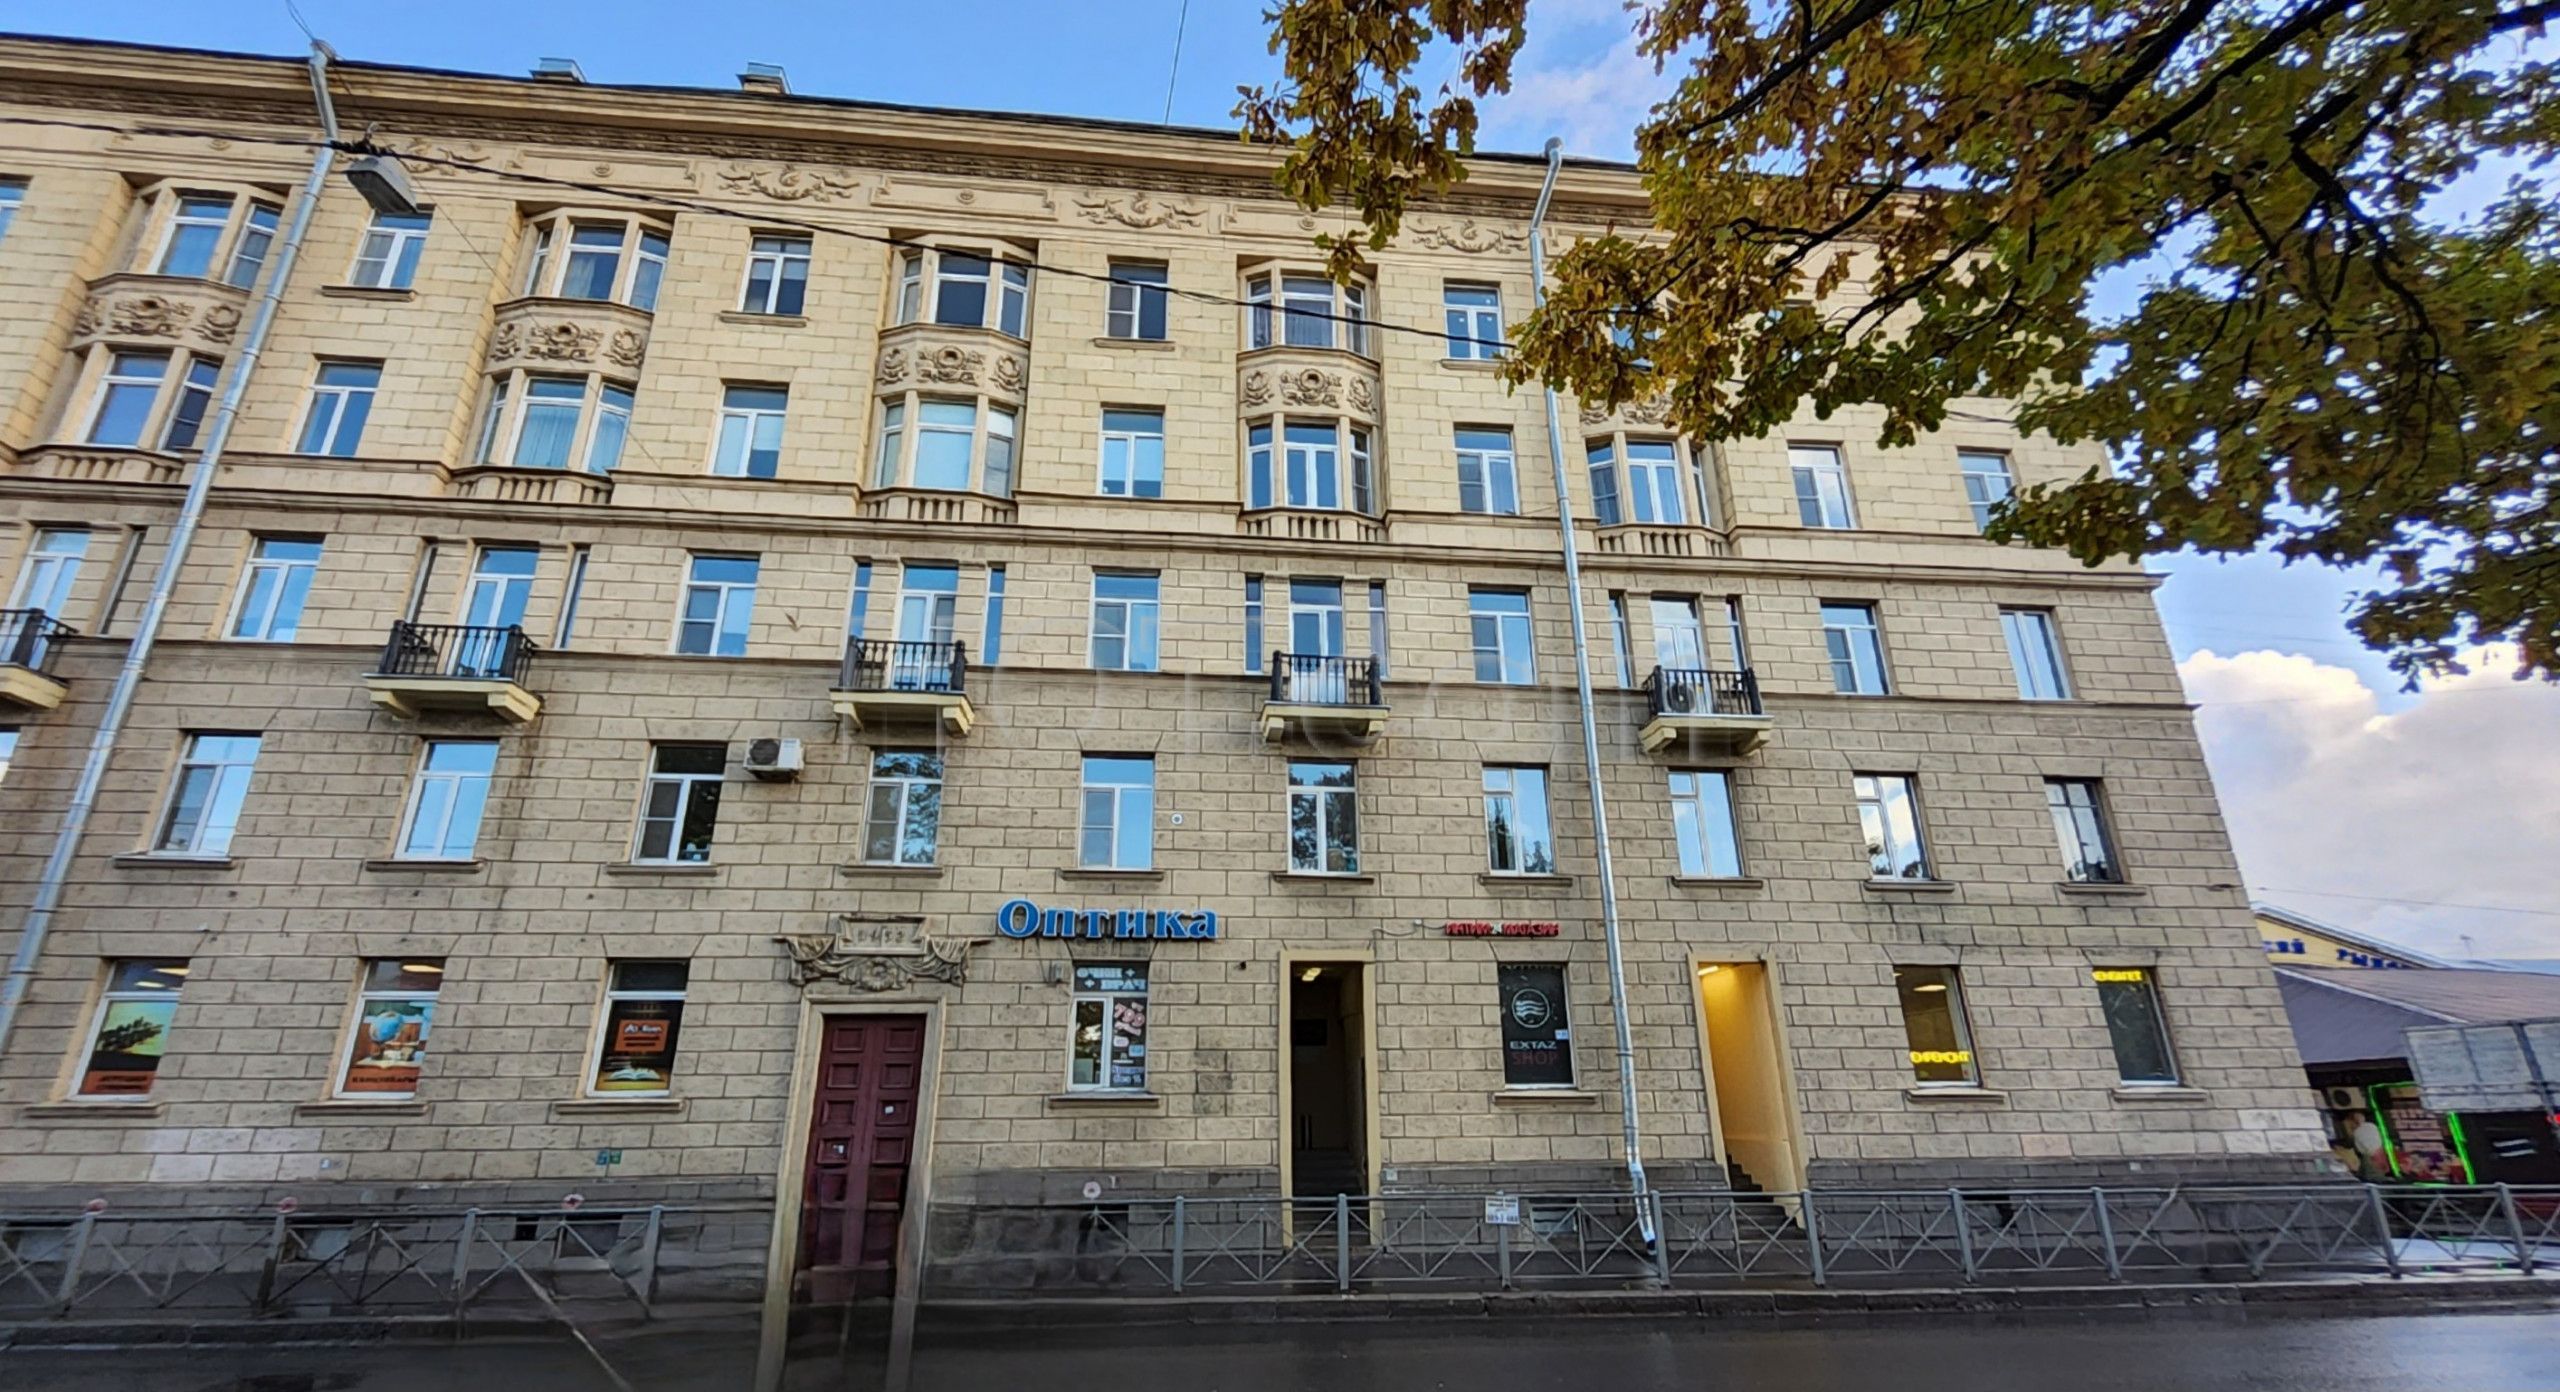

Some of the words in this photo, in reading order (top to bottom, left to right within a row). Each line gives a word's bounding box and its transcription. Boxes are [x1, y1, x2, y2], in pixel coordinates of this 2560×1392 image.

[998, 899, 1217, 939] Оптика
[1501, 921, 1560, 937] МАГАЗИН
[1100, 979, 1146, 990] ВРАЧ
[1510, 1040, 1557, 1050] EXTAZ
[1512, 1051, 1560, 1065] SHOP
